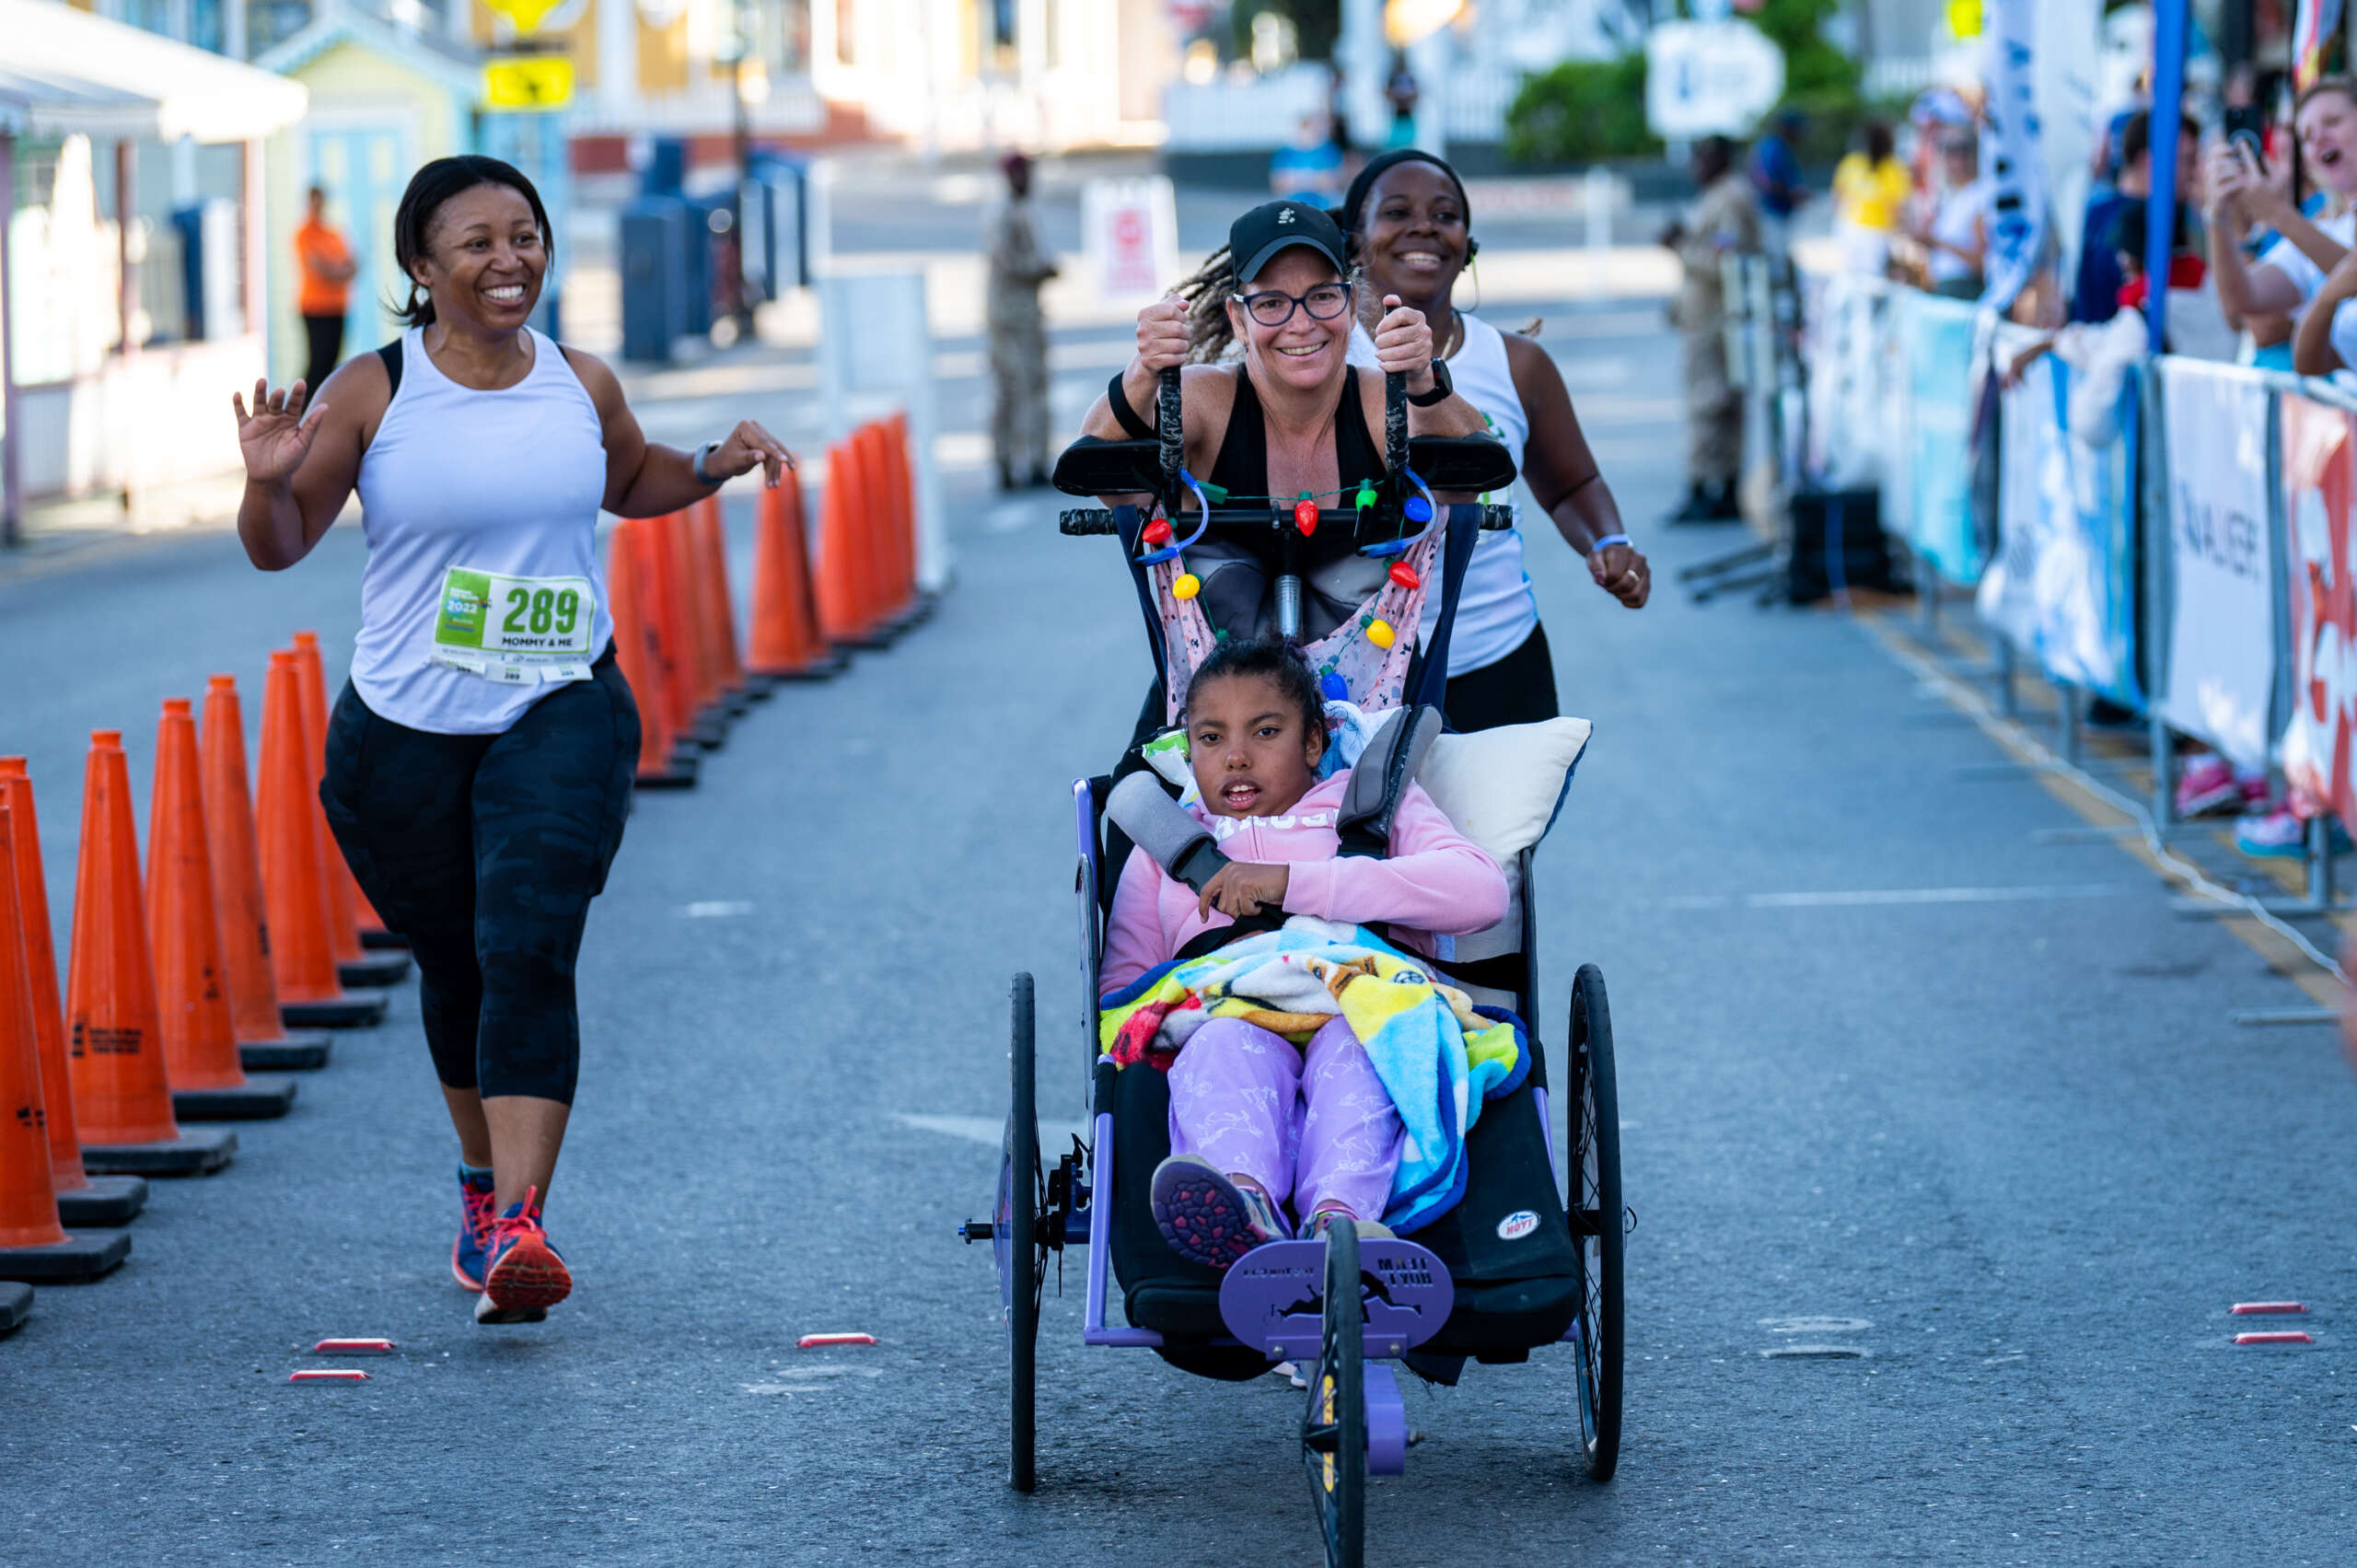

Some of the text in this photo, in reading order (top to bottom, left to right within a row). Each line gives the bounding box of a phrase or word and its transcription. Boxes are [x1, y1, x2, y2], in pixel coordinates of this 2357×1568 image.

[447, 599, 477, 614] 2022
[503, 587, 579, 633] 289
[502, 637, 544, 645] MOMMY
[1506, 1218, 1533, 1236] HOYT
